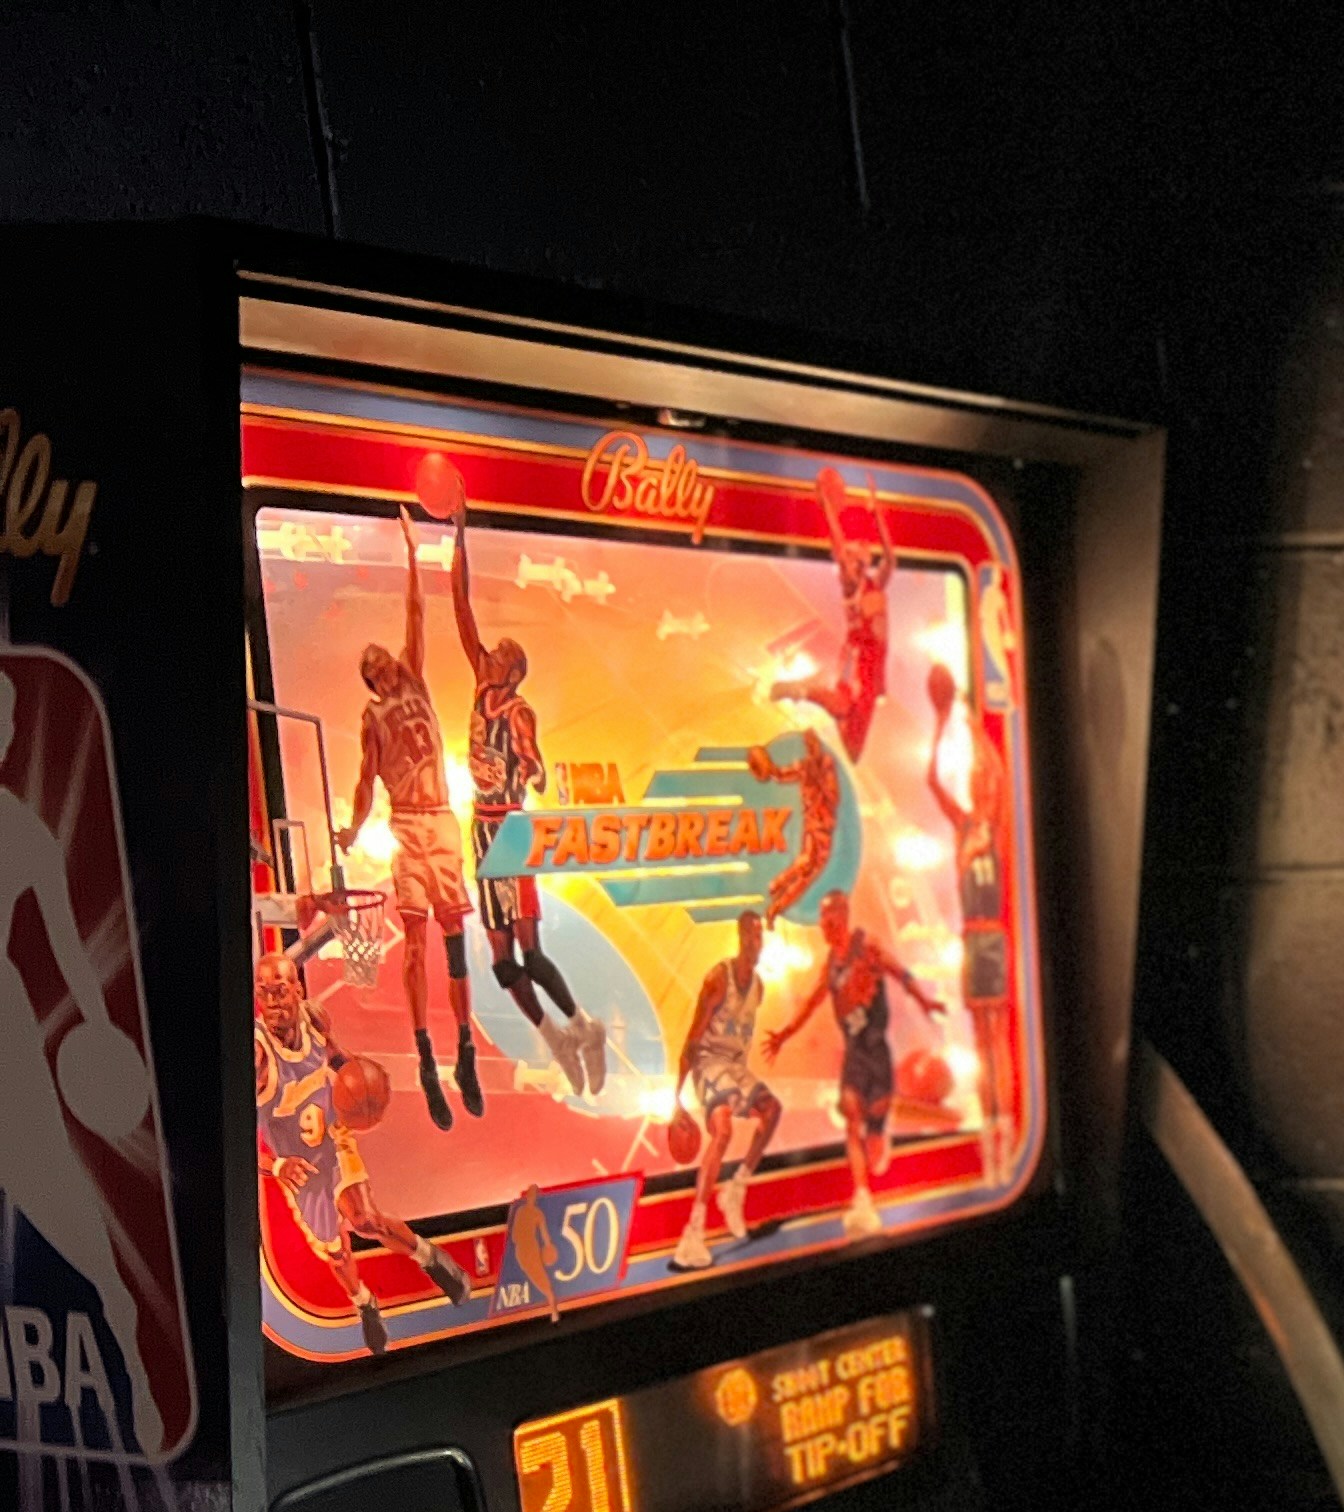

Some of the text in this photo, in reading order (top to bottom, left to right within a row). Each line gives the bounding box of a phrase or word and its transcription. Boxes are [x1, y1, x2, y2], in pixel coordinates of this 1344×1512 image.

[581, 430, 715, 545] Bally
[569, 762, 625, 805] NBA
[525, 807, 793, 868] FASTBREAK
[554, 1197, 619, 1282] 50
[496, 1281, 530, 1311] NBA
[0, 1304, 117, 1405] BA
[836, 1336, 906, 1380] CENTER
[779, 1365, 910, 1443] RAMP FOR
[784, 1404, 912, 1485] TIP-OFF
